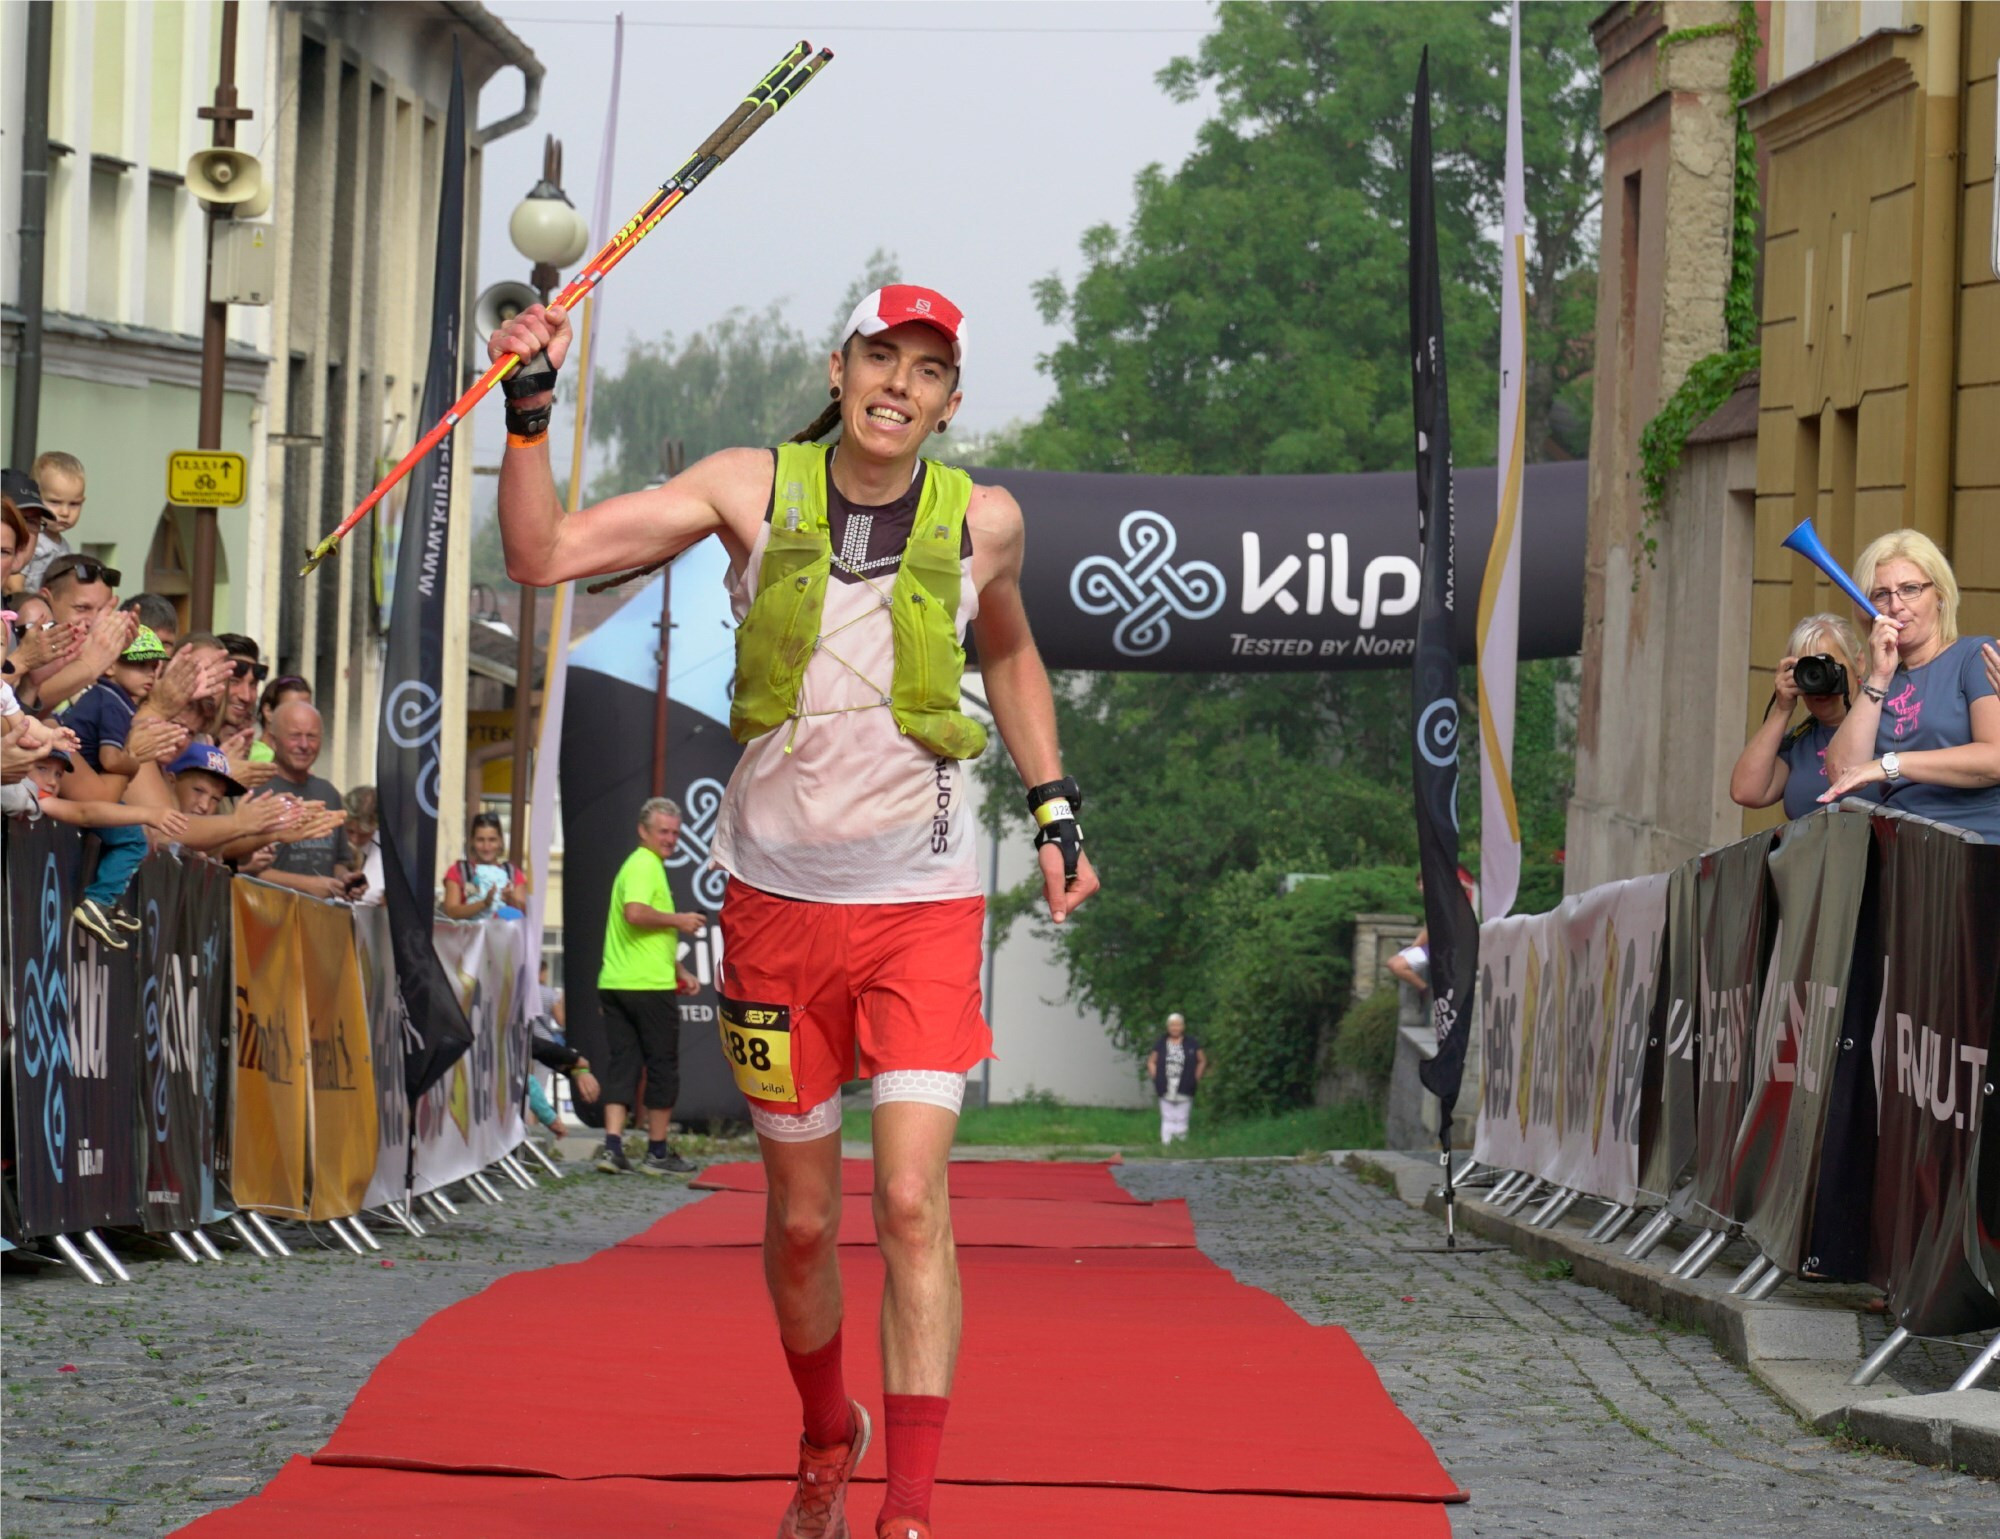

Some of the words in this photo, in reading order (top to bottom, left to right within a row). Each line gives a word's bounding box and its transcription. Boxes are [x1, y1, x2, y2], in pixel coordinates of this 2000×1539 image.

[613, 213, 643, 248] LEKI
[1241, 531, 1421, 630] kilp
[1353, 634, 1416, 656] NORT
[678, 1004, 714, 1022] TED
[722, 1020, 772, 1072] 88
[761, 1082, 786, 1094] kilpi
